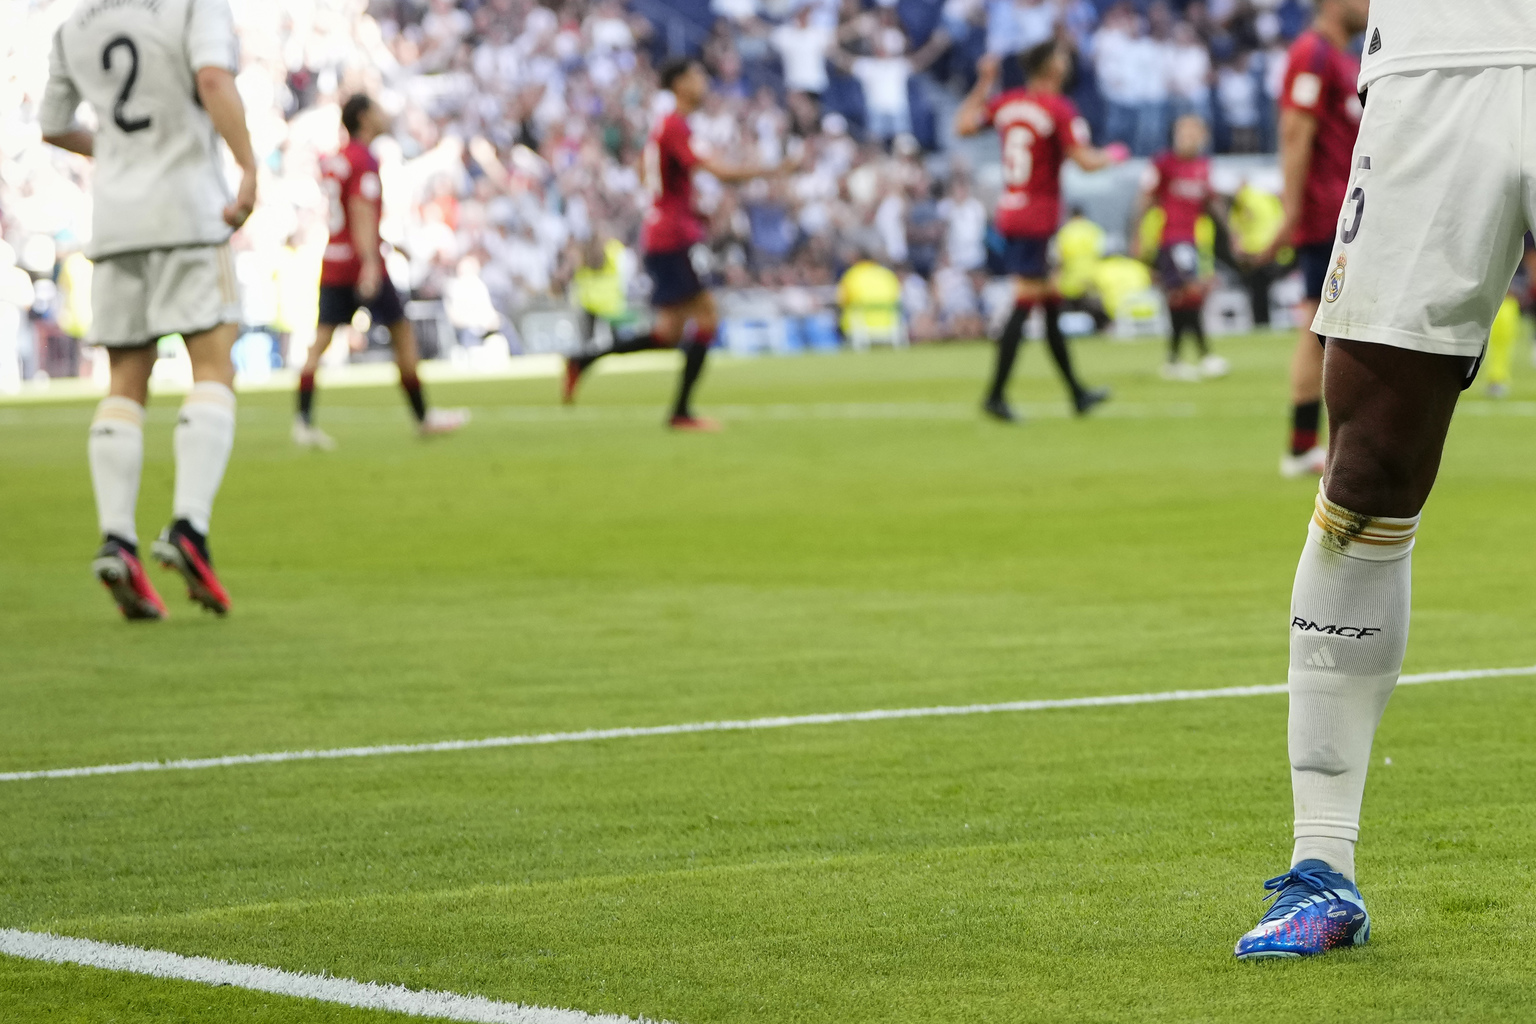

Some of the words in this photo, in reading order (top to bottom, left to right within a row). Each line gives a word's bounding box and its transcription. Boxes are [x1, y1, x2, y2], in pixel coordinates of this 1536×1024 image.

[102, 36, 151, 133] 2
[1341, 156, 1371, 244] 5
[1291, 617, 1382, 640] RMCF
